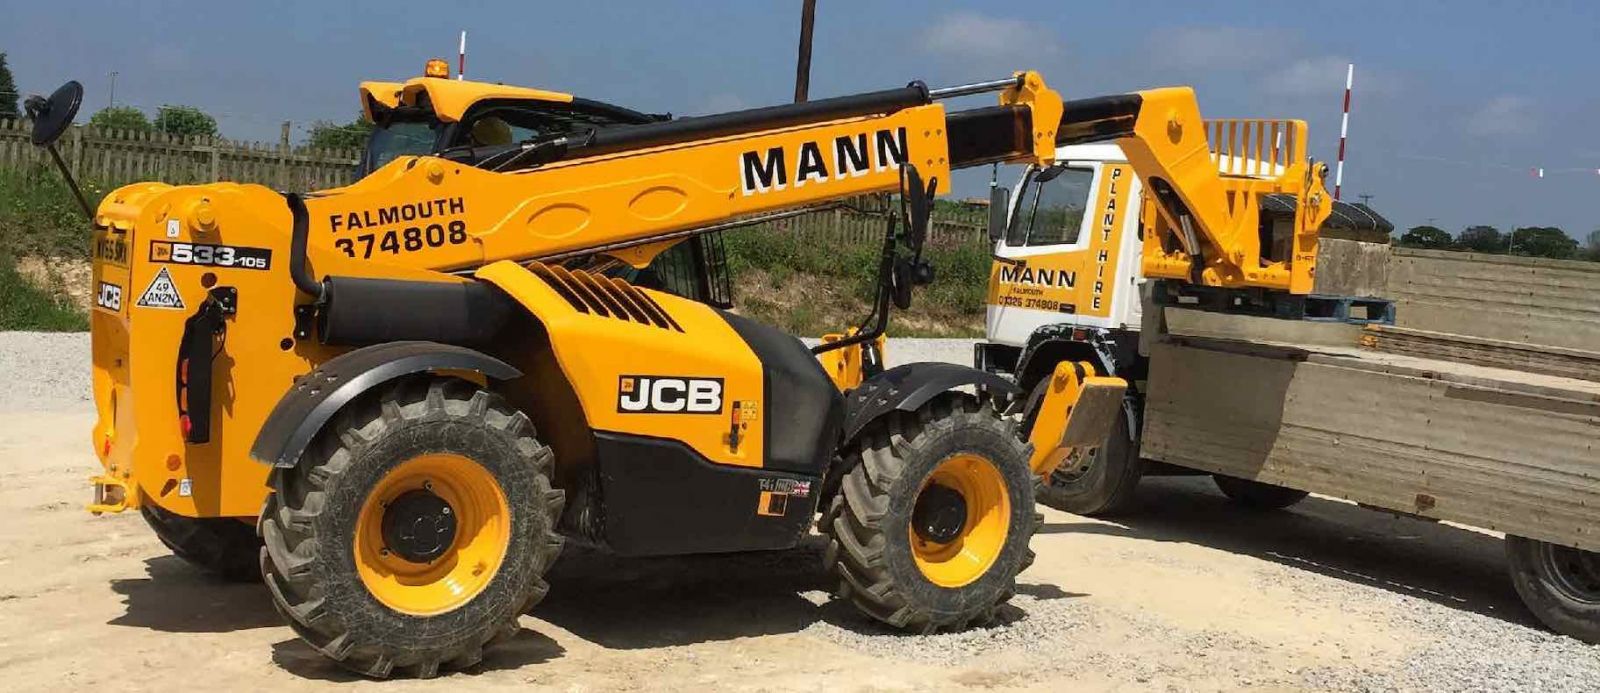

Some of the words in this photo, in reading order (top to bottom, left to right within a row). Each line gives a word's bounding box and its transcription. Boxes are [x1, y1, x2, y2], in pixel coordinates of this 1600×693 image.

[740, 127, 909, 196] MANN
[330, 197, 465, 233] FALMOUTH
[1104, 168, 1122, 241] PLANT
[335, 220, 467, 260] 374808
[156, 282, 169, 292] 49
[1000, 265, 1077, 289] MANN
[1093, 250, 1108, 309] HIRE
[98, 283, 121, 311] JCB
[620, 378, 722, 412] JCB
